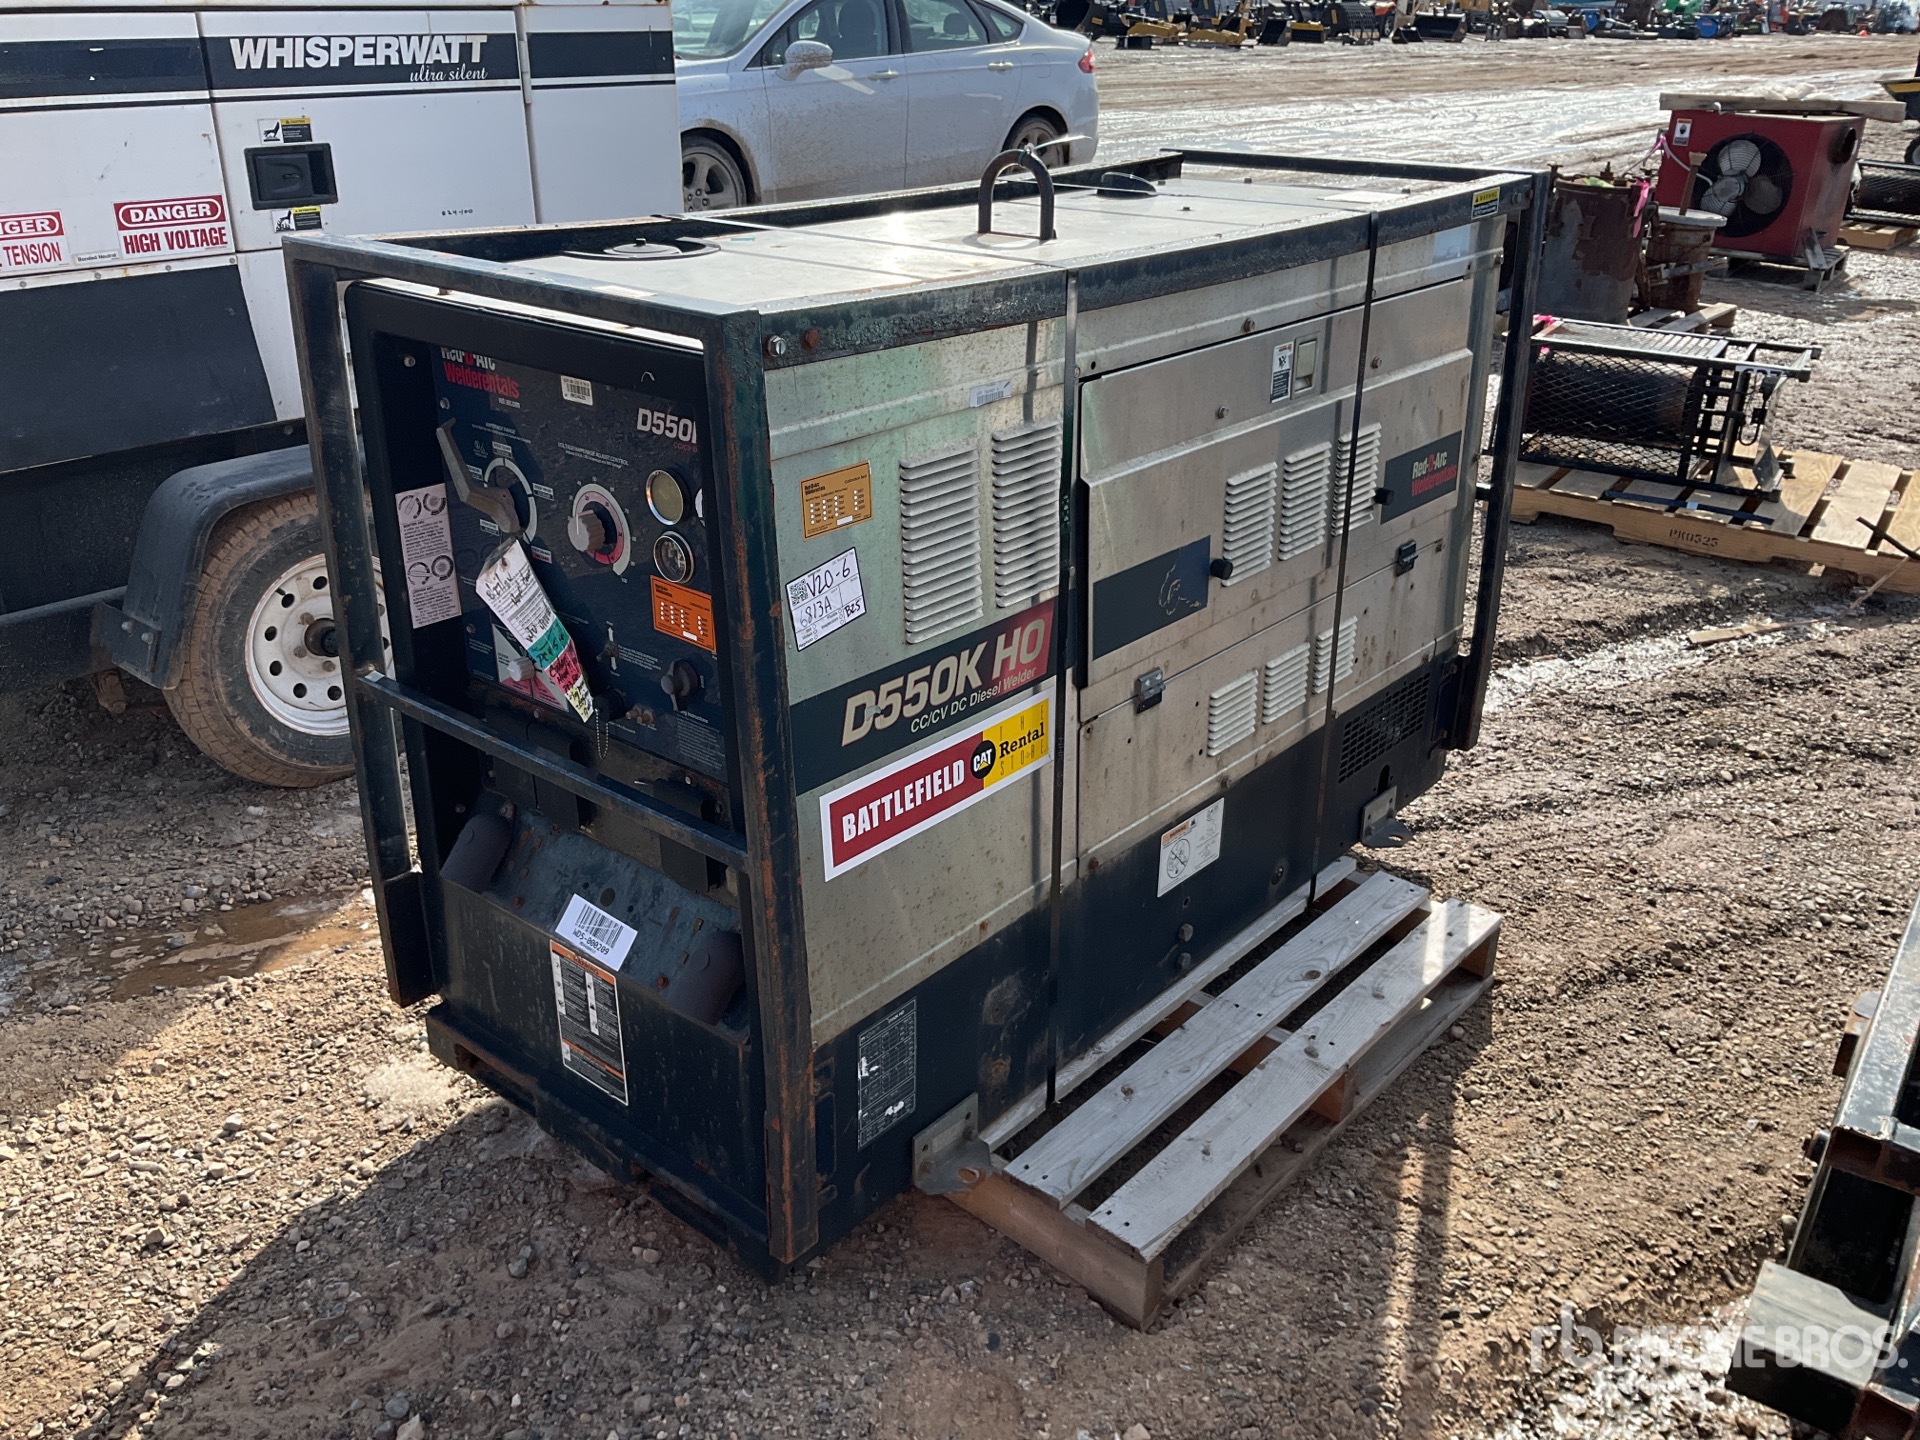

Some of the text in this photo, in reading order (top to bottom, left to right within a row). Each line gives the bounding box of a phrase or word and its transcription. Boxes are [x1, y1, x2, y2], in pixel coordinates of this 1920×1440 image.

[230, 35, 488, 69] WHISPERWATT
[409, 63, 488, 82] ultra silent
[130, 204, 211, 223] DANGER
[4, 241, 62, 266] TENSION
[123, 226, 228, 254] HIGH VOLTAGE
[444, 362, 520, 399] Welderentals
[800, 595, 833, 628] 6813A
[841, 617, 1046, 747] D550K HO
[910, 666, 1037, 733] CC/CV DC Diesel Welder
[841, 721, 1046, 844] BATTLEFIELD CAT Rental
